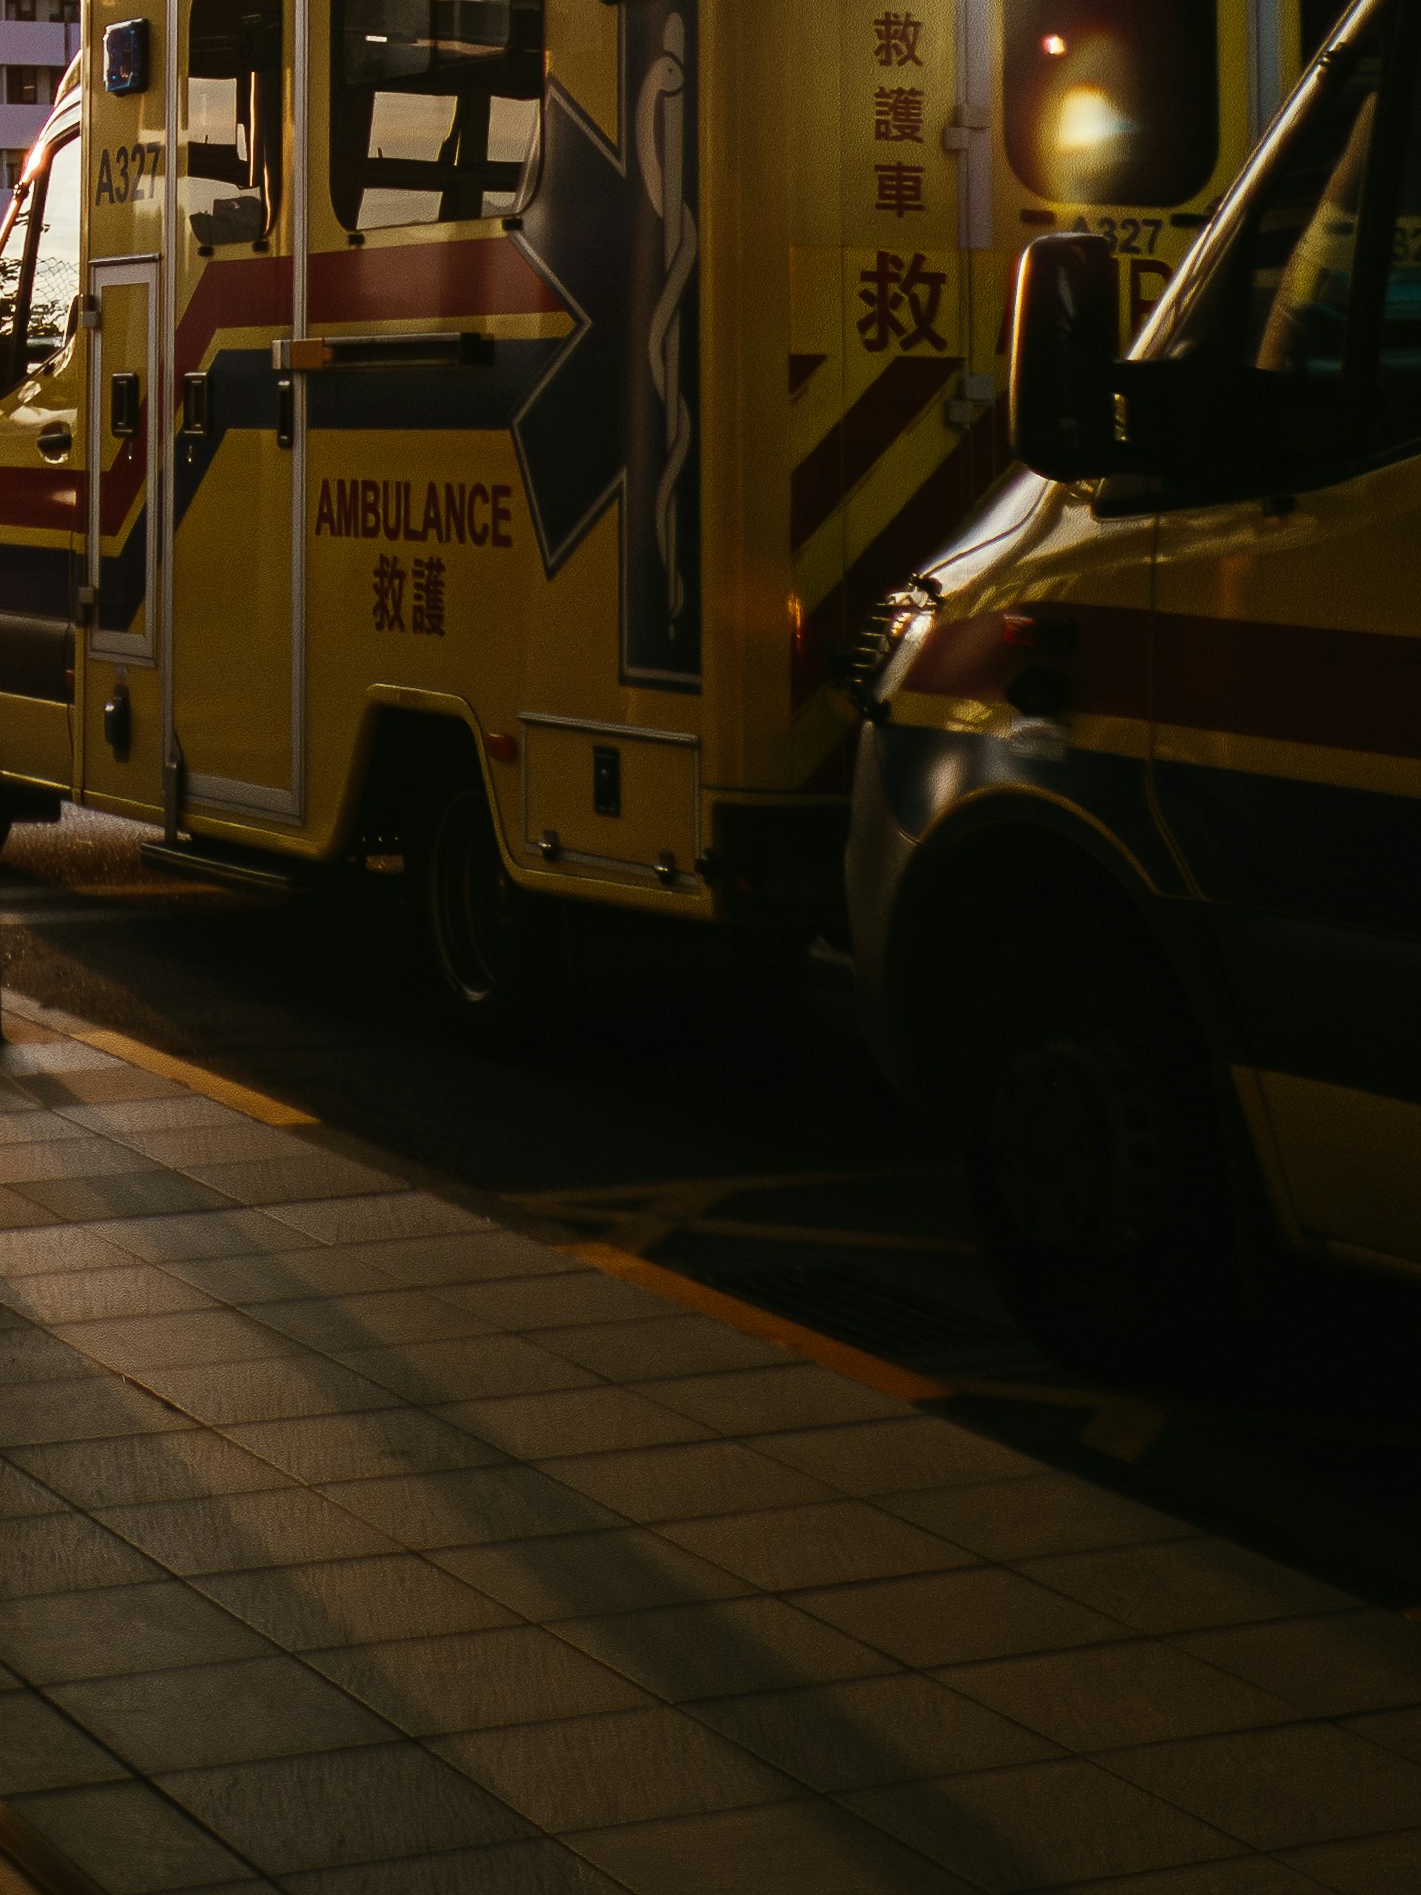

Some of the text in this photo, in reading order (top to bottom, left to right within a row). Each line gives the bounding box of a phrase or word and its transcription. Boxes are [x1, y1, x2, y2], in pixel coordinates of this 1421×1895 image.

[873, 11, 926, 219] 救護車
[94, 141, 162, 206] A327
[856, 250, 948, 354] 救
[314, 478, 513, 548] AMBULANCE
[371, 555, 447, 638] 救護
